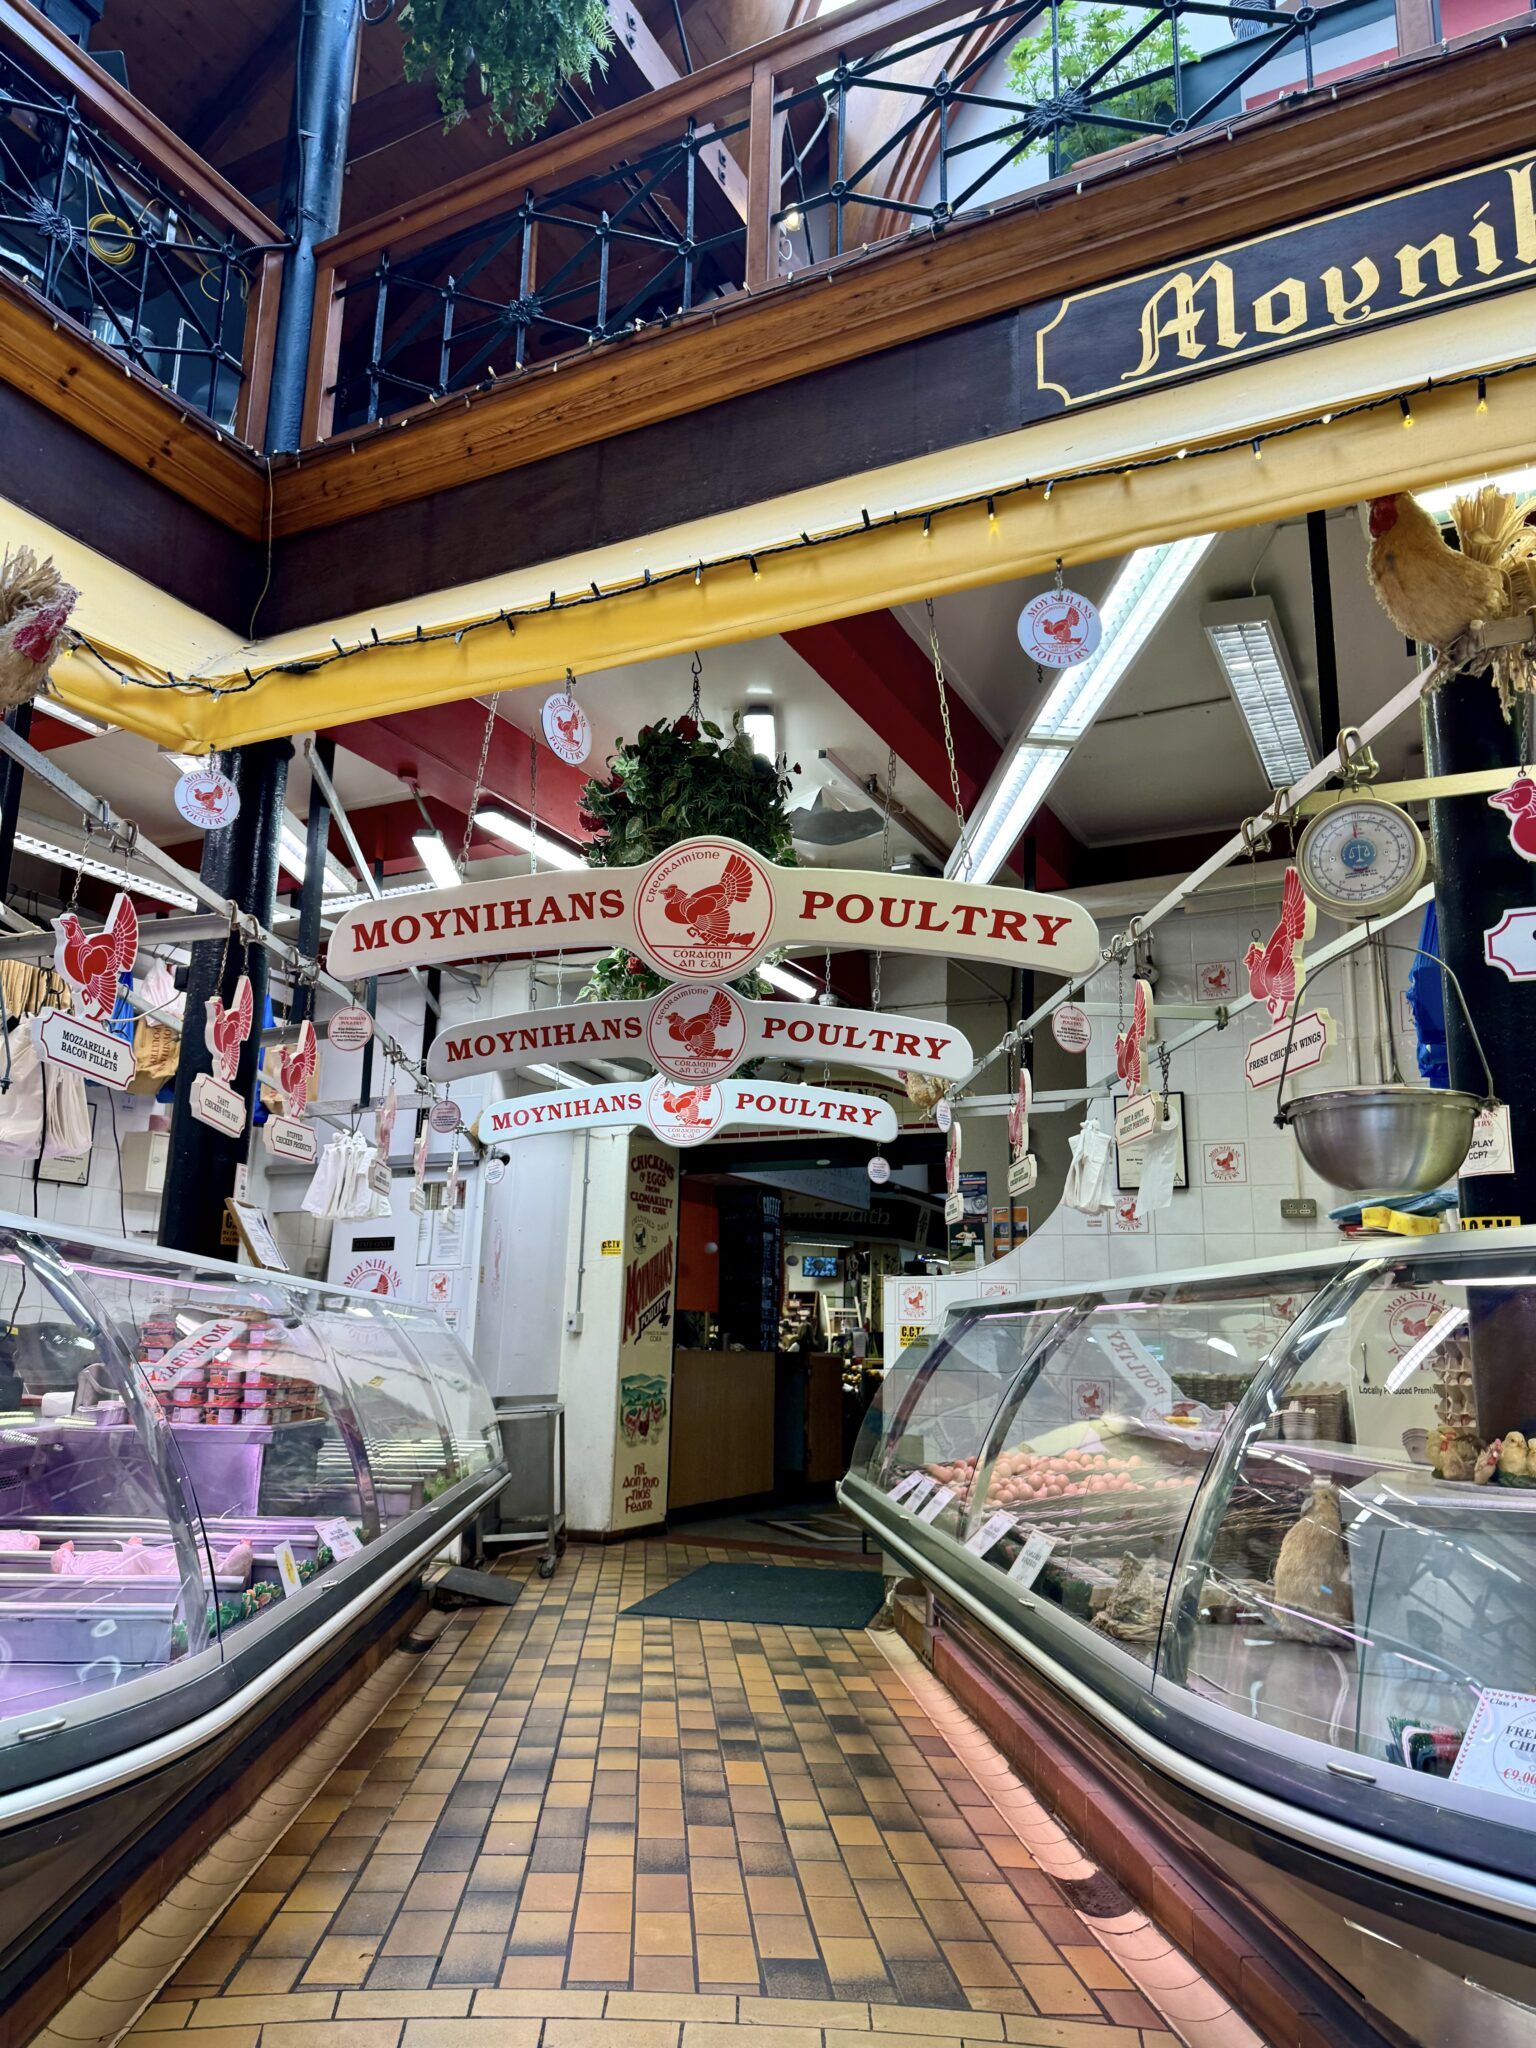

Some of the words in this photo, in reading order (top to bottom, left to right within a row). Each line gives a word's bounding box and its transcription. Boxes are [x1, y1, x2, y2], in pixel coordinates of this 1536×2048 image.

[1027, 594, 1095, 619] MOYNIHANS
[1030, 645, 1089, 664] POULTRY
[181, 805, 226, 825] POULTRY
[352, 888, 625, 953] MOYNIHANS
[799, 890, 1073, 947] POULTRY
[62, 1030, 111, 1059] MOZZARELLA
[112, 1051, 119, 1061] &
[446, 1016, 642, 1063] MOYNIHANS
[761, 1017, 951, 1060] POULTRY
[1248, 1054, 1269, 1072] FRESH
[1299, 1031, 1322, 1049] WINGS
[61, 1041, 88, 1060] BACON
[88, 1053, 118, 1072] FILLETS
[204, 1098, 222, 1113] CHICKEN
[217, 1095, 230, 1109] TASTY
[491, 1093, 642, 1131] MOYNIHANS
[736, 1093, 882, 1126] POULTRY
[276, 1135, 293, 1147] CHICKEN
[293, 1140, 312, 1152] PRODUCTS
[630, 1153, 675, 1181] CHICKENS
[646, 1171, 666, 1187] EGGS
[344, 1259, 402, 1288] MOYNIHANS
[1384, 1291, 1453, 1316] MOYNIHA
[1359, 1385, 1382, 1396] Locally
[1489, 1697, 1510, 1707] Class
